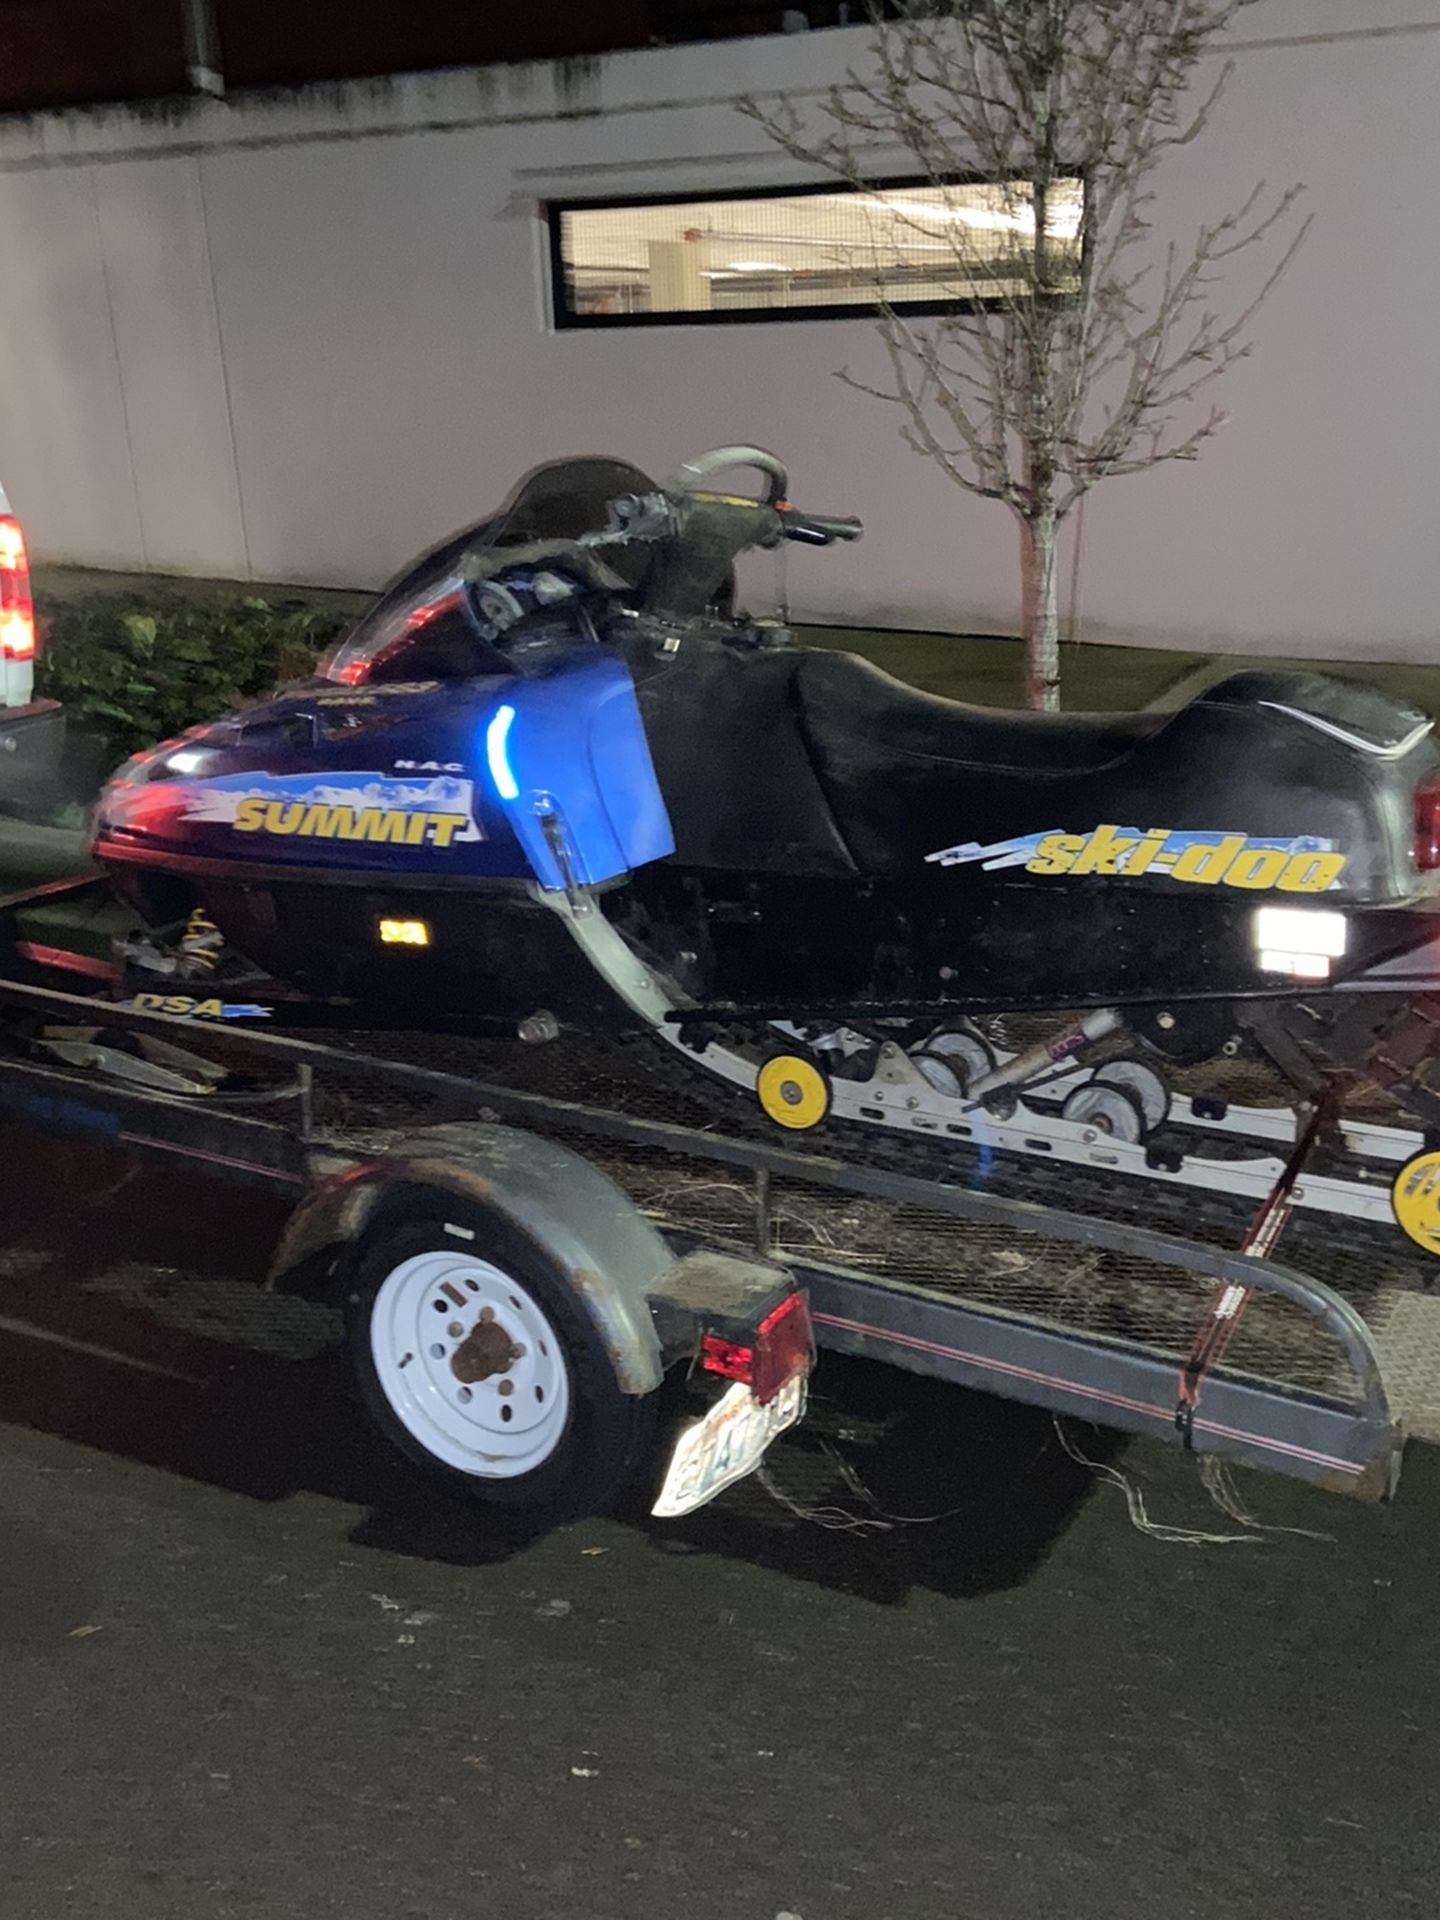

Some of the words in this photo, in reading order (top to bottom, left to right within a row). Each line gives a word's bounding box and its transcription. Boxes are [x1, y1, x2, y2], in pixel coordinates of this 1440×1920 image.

[233, 798, 467, 847] SUMMIT
[1025, 824, 1347, 892] ski-doo
[131, 993, 222, 1017] DSA
